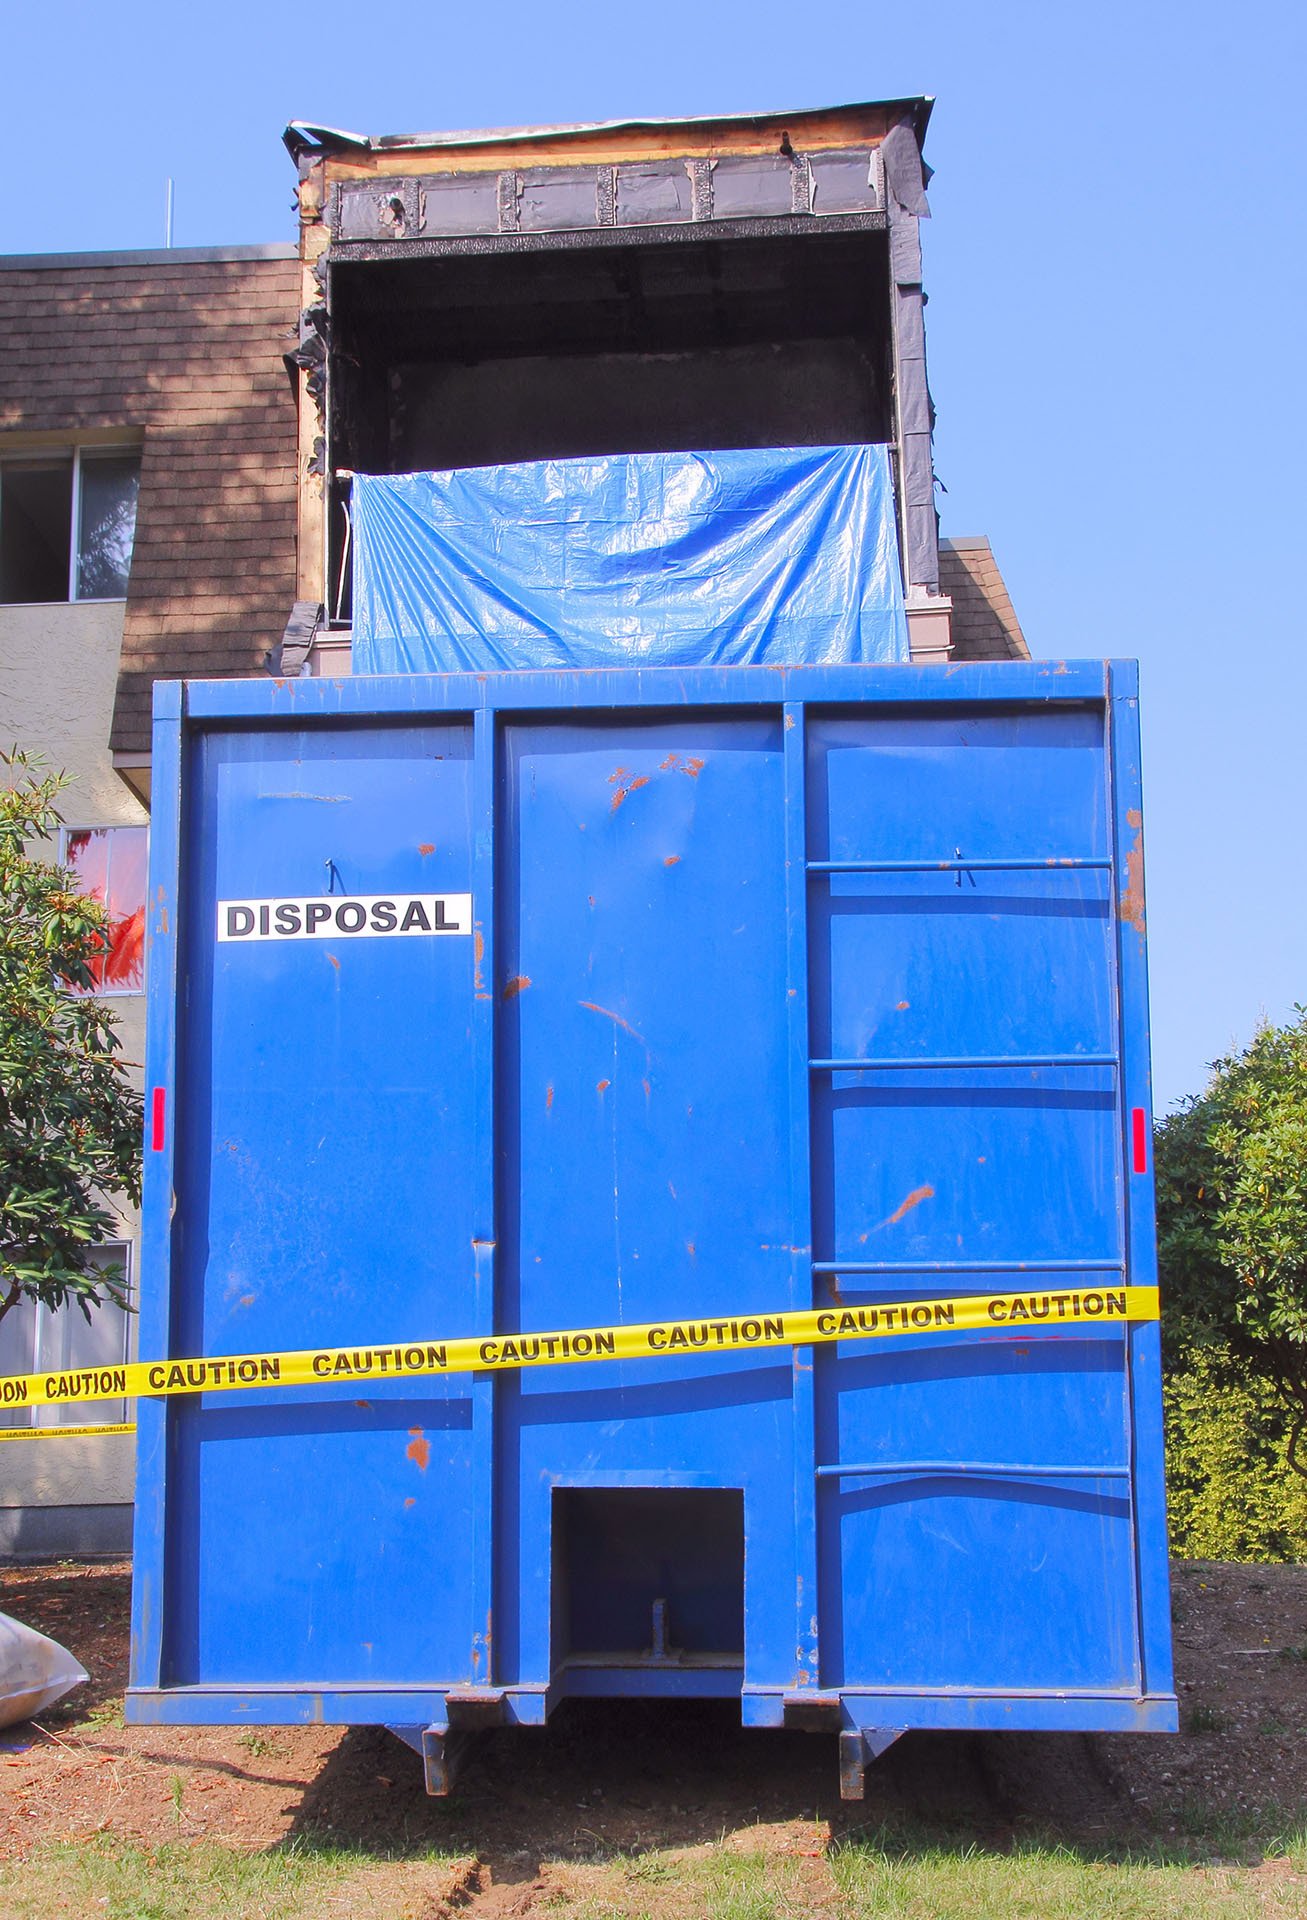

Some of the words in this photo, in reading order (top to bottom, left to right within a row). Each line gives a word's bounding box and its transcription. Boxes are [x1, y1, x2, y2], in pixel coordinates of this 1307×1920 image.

[227, 901, 460, 937] DISPOSAL
[45, 1370, 126, 1398] CAUTION
[149, 1358, 280, 1389] CAUTION
[312, 1345, 448, 1377] CAUTION
[479, 1331, 616, 1364] CAUTION
[647, 1317, 784, 1350] CAUTION
[816, 1303, 955, 1336] CAUTION
[987, 1292, 1127, 1322] CAUTION
